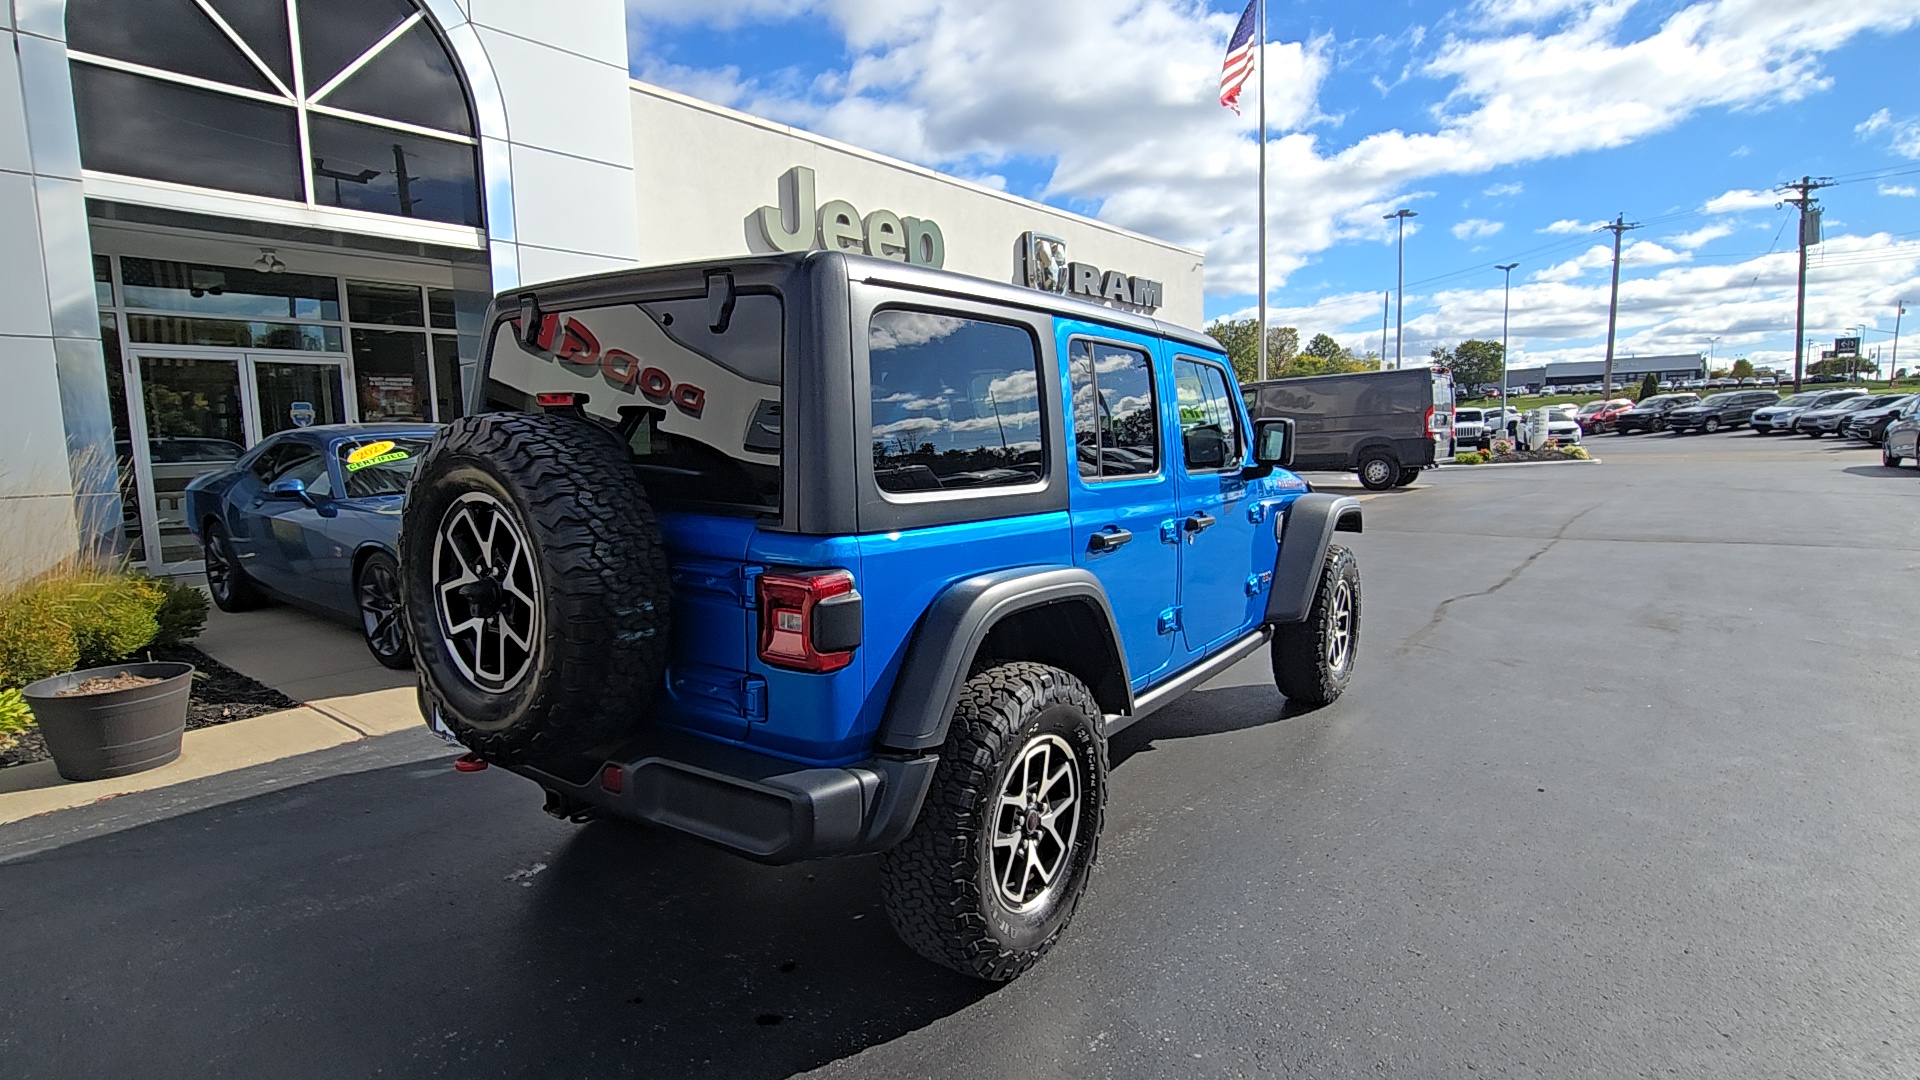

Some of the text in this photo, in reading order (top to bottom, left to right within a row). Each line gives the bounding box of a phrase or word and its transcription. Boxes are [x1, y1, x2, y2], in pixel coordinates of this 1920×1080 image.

[746, 165, 945, 270] Jeep
[1068, 262, 1164, 308] RAM
[348, 452, 405, 471] CERTIFIED
[356, 442, 388, 461] 2023
